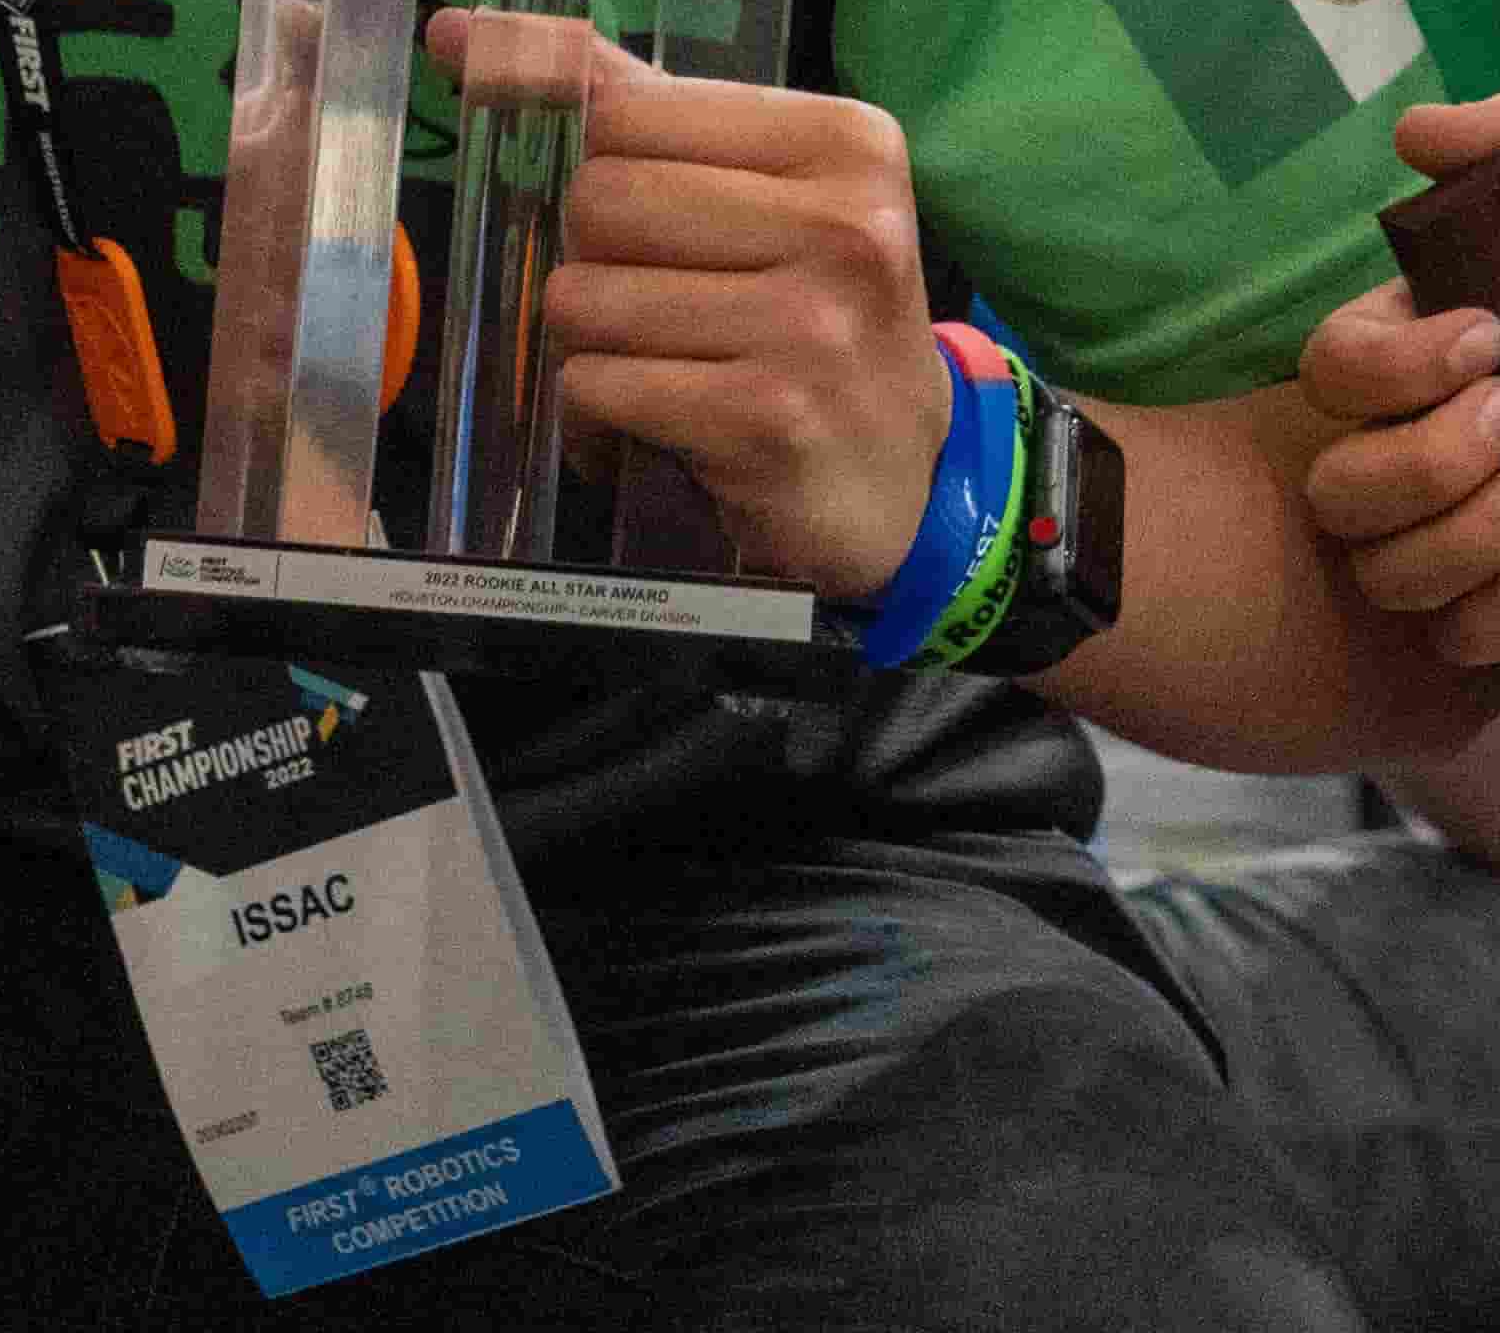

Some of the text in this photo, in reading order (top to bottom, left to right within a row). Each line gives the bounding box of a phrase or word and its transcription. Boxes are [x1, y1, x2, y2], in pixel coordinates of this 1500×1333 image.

[10, 16, 50, 112] FIRST
[424, 570, 669, 604] 2022 ROOKIE ALL STAR AWARD
[579, 605, 637, 622] CARVER
[640, 610, 702, 626] DIVISION
[116, 719, 194, 772] FIRST
[123, 717, 311, 811] CHAMPIONSHIP
[264, 757, 316, 790] 2022
[230, 874, 355, 948] ISSAC
[279, 1003, 319, 1025] Team
[384, 1136, 521, 1200] ROBOTICS
[332, 1181, 509, 1254] COMPETITION
